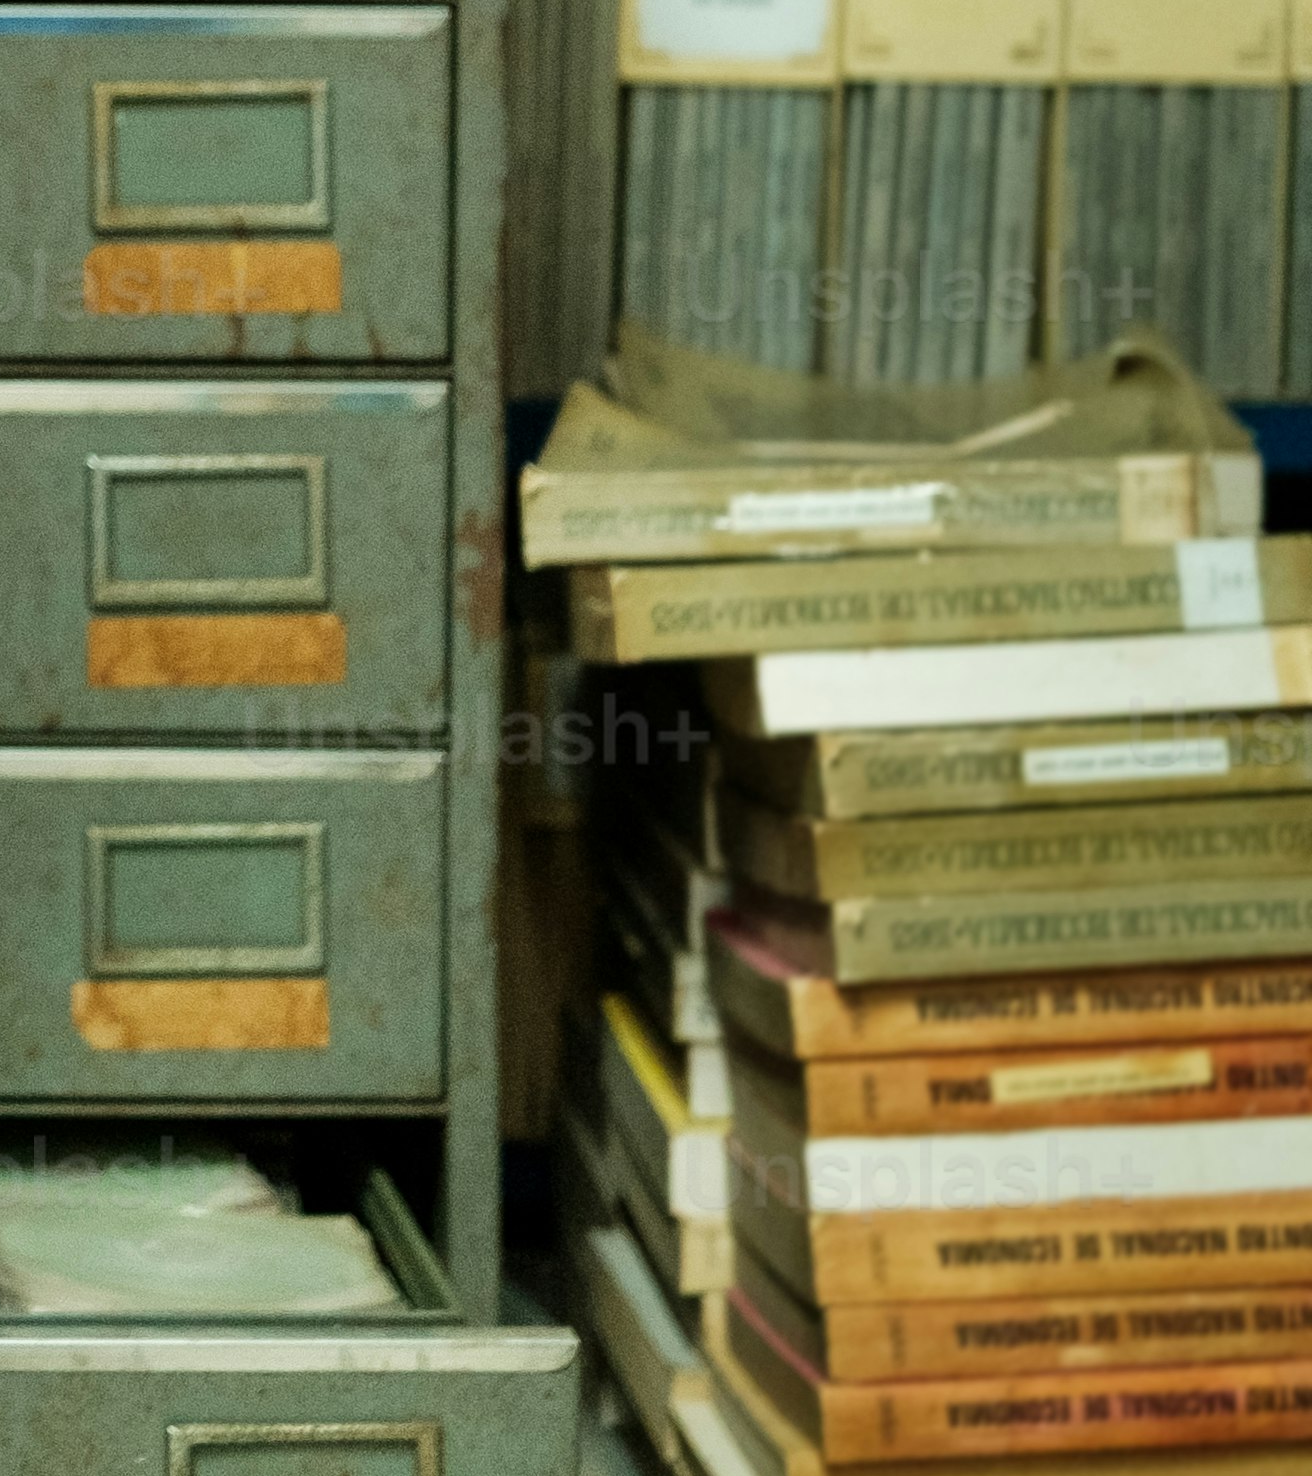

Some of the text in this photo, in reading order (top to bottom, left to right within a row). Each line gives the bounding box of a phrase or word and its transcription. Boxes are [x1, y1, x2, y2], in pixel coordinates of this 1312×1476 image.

[936, 1236, 1061, 1269] ECONOMIA
[1074, 1232, 1101, 1263] DE
[1111, 1228, 1228, 1260] NACIONAL
